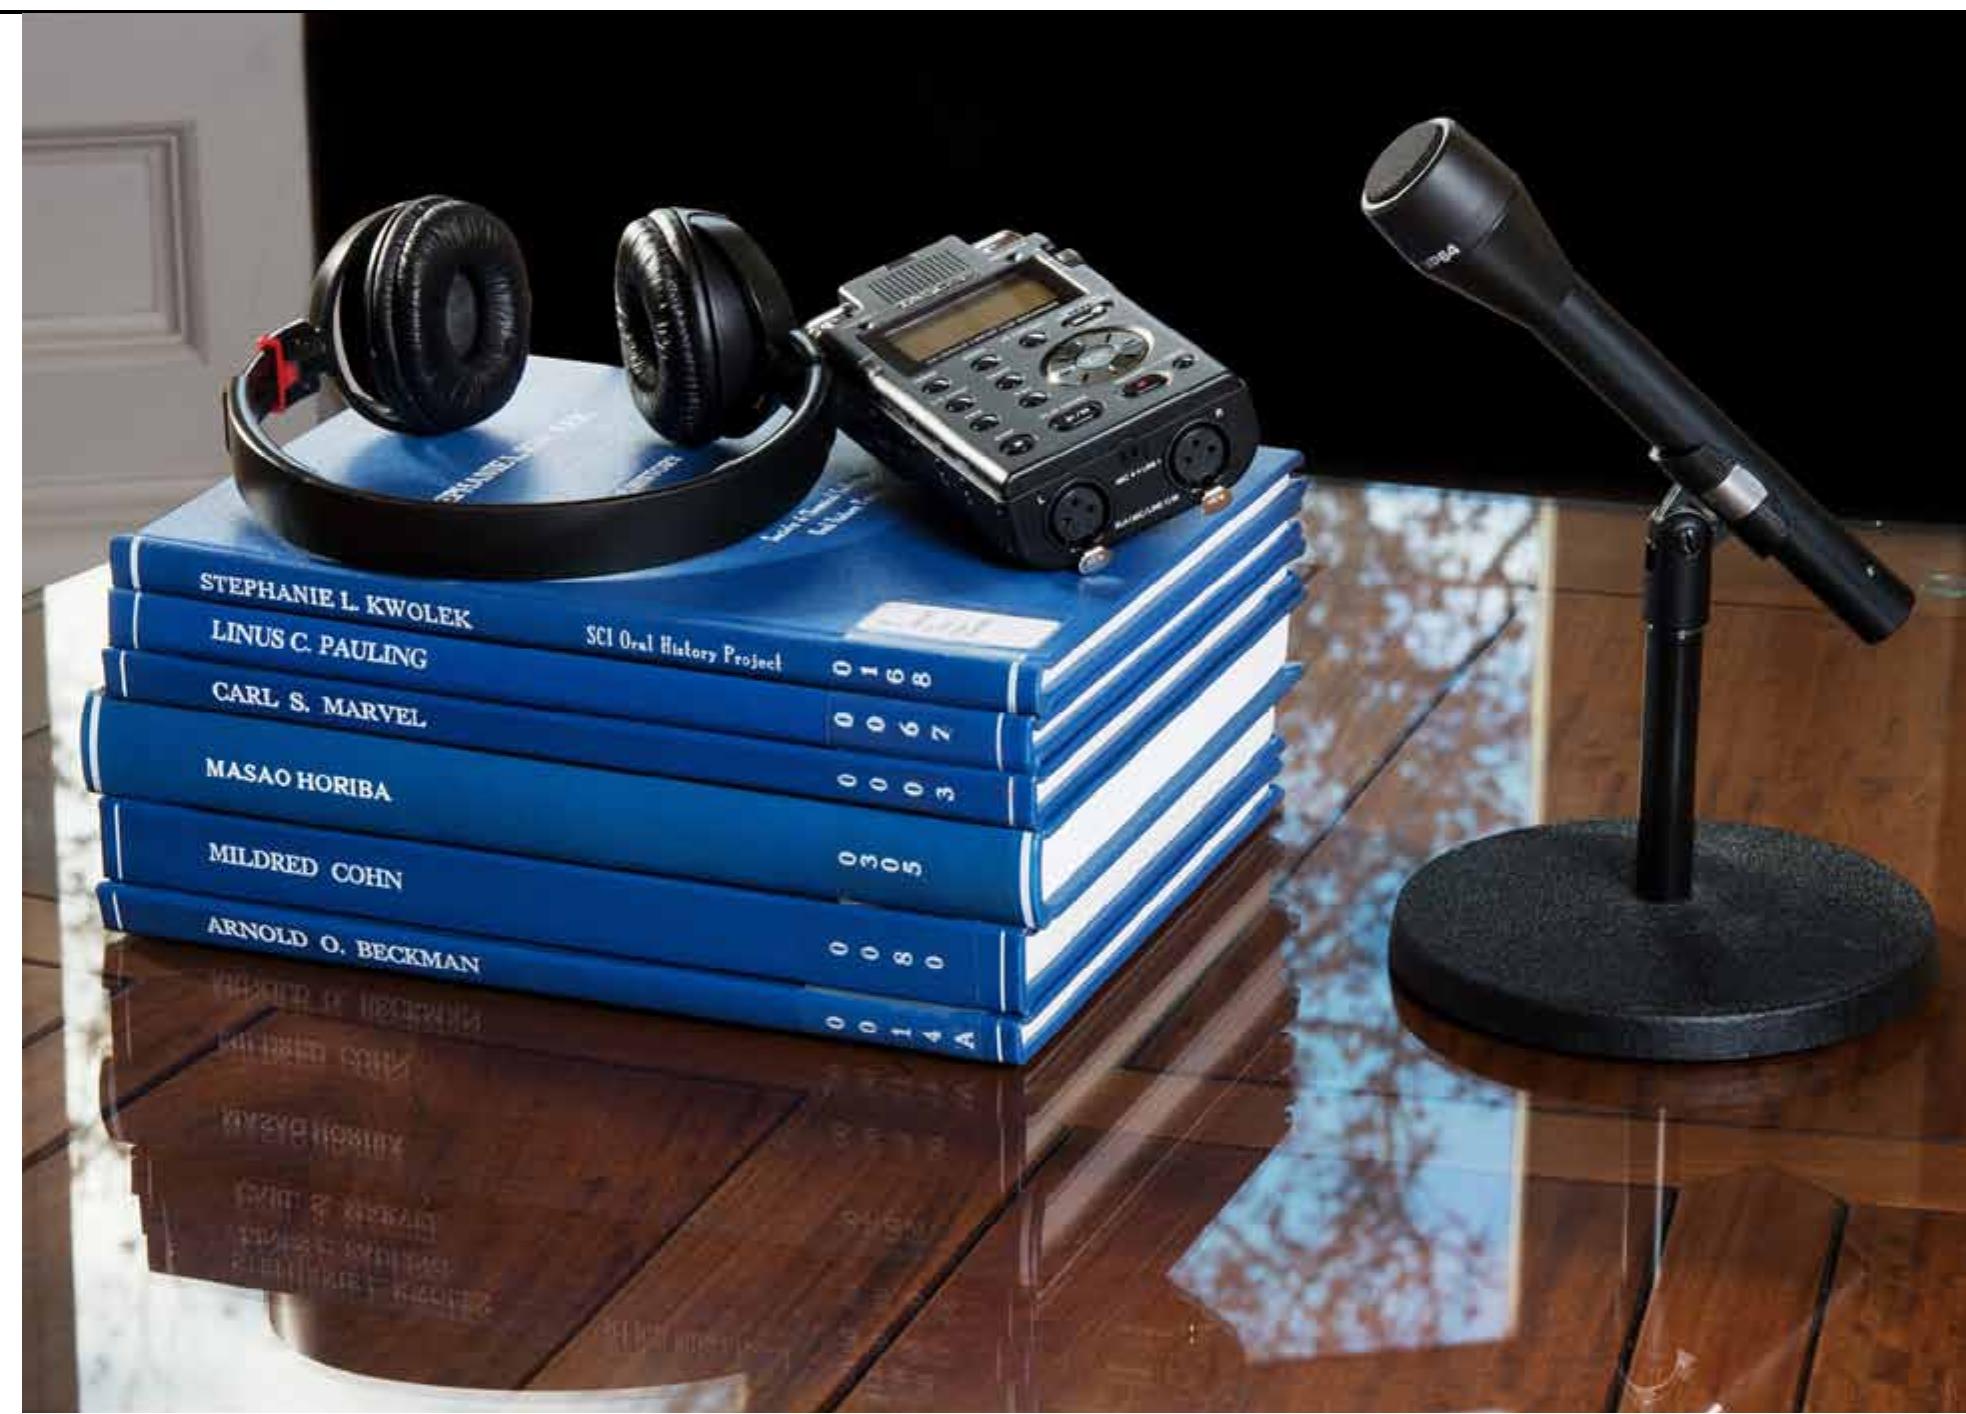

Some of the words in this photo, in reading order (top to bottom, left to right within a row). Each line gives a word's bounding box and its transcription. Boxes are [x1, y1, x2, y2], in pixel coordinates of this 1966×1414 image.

[200, 572, 336, 608] STEPHANIE
[340, 590, 360, 611] L.
[365, 594, 474, 630] KWOLEK
[211, 619, 285, 650] LINUS
[289, 631, 312, 652] C.
[319, 634, 428, 670] PAULING
[586, 625, 613, 647] SCI
[619, 629, 653, 652] Oral
[660, 635, 717, 663] History
[724, 644, 782, 673] Project
[212, 681, 280, 708] CARL
[289, 691, 311, 713] S.
[321, 696, 427, 728] MARVEL
[205, 757, 292, 788] MASAO
[296, 771, 392, 802] HORIBA
[209, 842, 319, 877] MILDRED
[331, 862, 403, 890] COHN
[207, 916, 309, 948] ARNOLD
[320, 935, 345, 955] O.
[355, 940, 480, 974] BECKMAN
